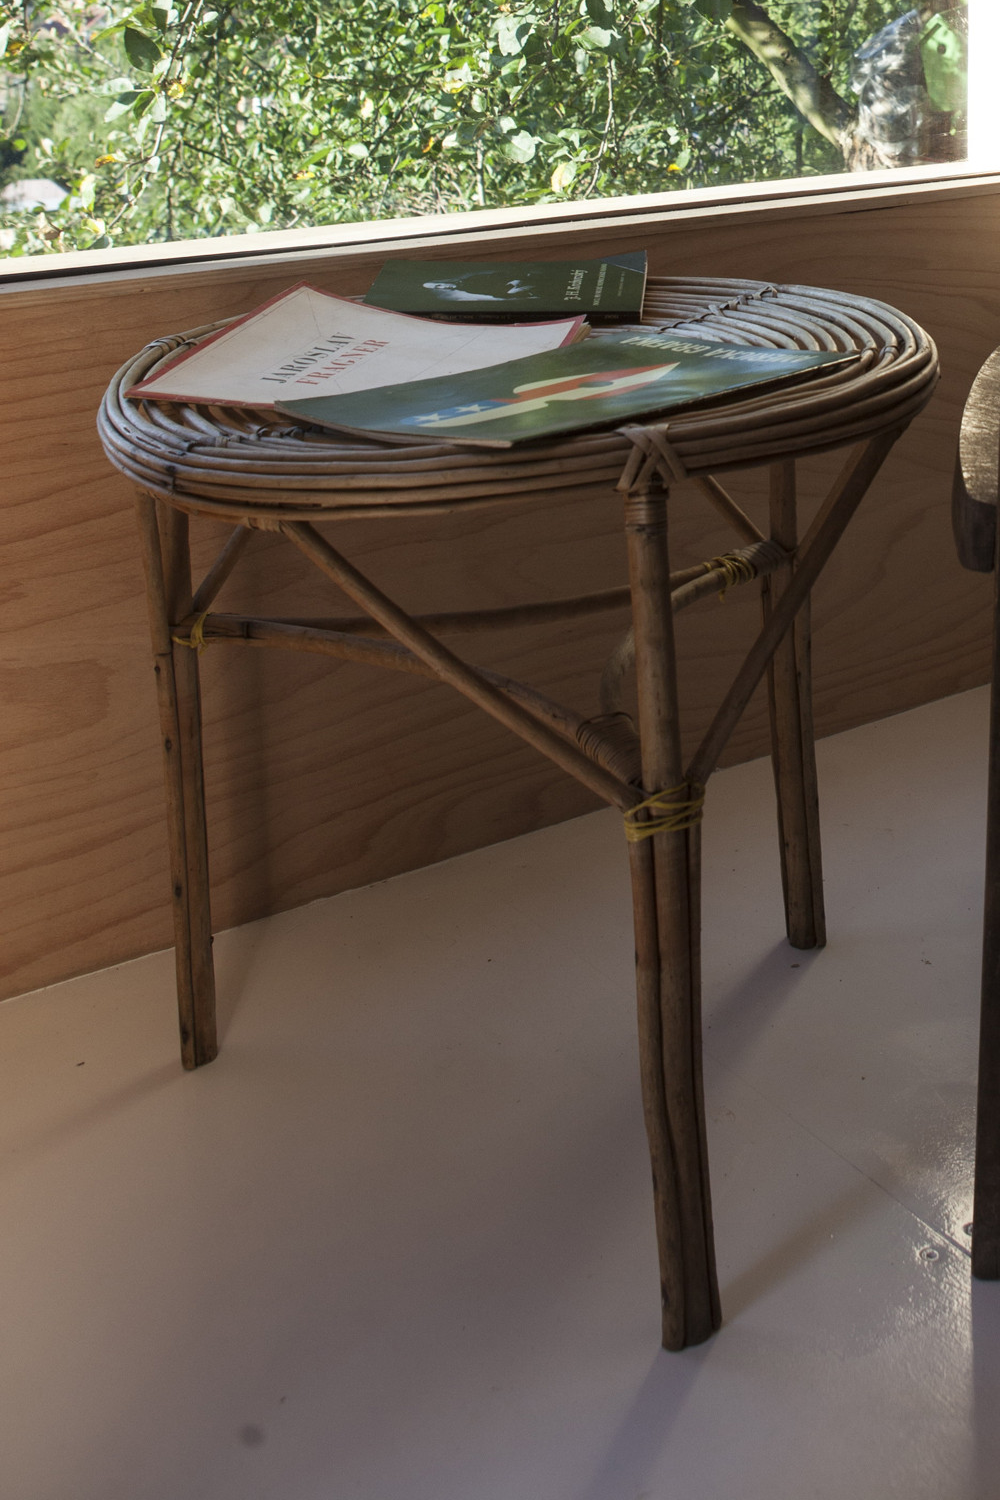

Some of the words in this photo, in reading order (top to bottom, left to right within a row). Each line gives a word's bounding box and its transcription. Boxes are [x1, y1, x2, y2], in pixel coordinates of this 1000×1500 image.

[260, 331, 355, 384] JAROSLAV
[296, 339, 390, 385] FRAGNER
[619, 336, 711, 354] GRAFIKA
